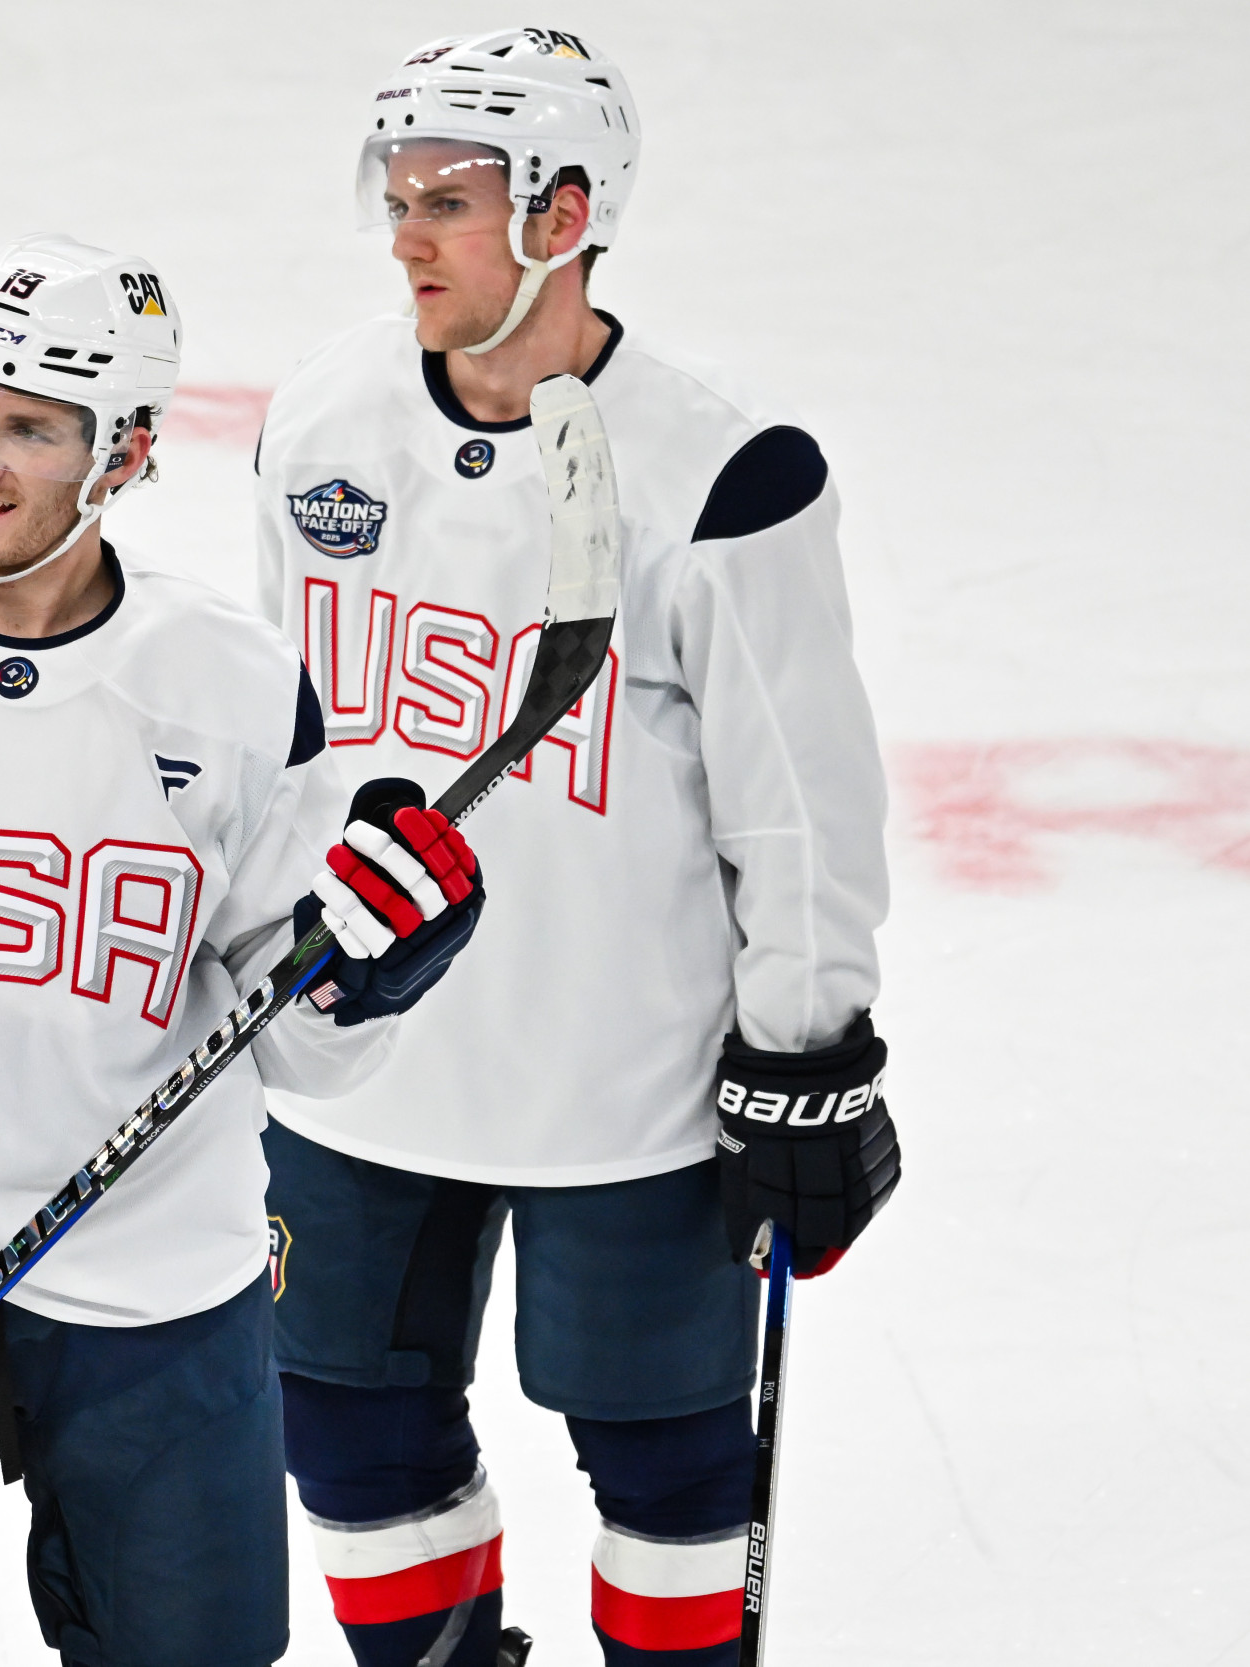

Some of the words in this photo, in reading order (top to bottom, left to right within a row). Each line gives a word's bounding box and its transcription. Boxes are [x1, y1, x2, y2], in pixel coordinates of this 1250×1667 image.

[0, 268, 47, 300] 19
[120, 273, 167, 316] CAT
[293, 498, 383, 521] NATIONS
[301, 516, 373, 534] FACE-OFF
[321, 534, 341, 542] 2025
[305, 577, 618, 816] USA
[451, 758, 518, 828] WOOD
[187, 1063, 223, 1100] BLACKLINE
[717, 1066, 886, 1126] BAUER
[762, 1381, 775, 1403] FOX
[745, 1521, 766, 1614] BAUER
